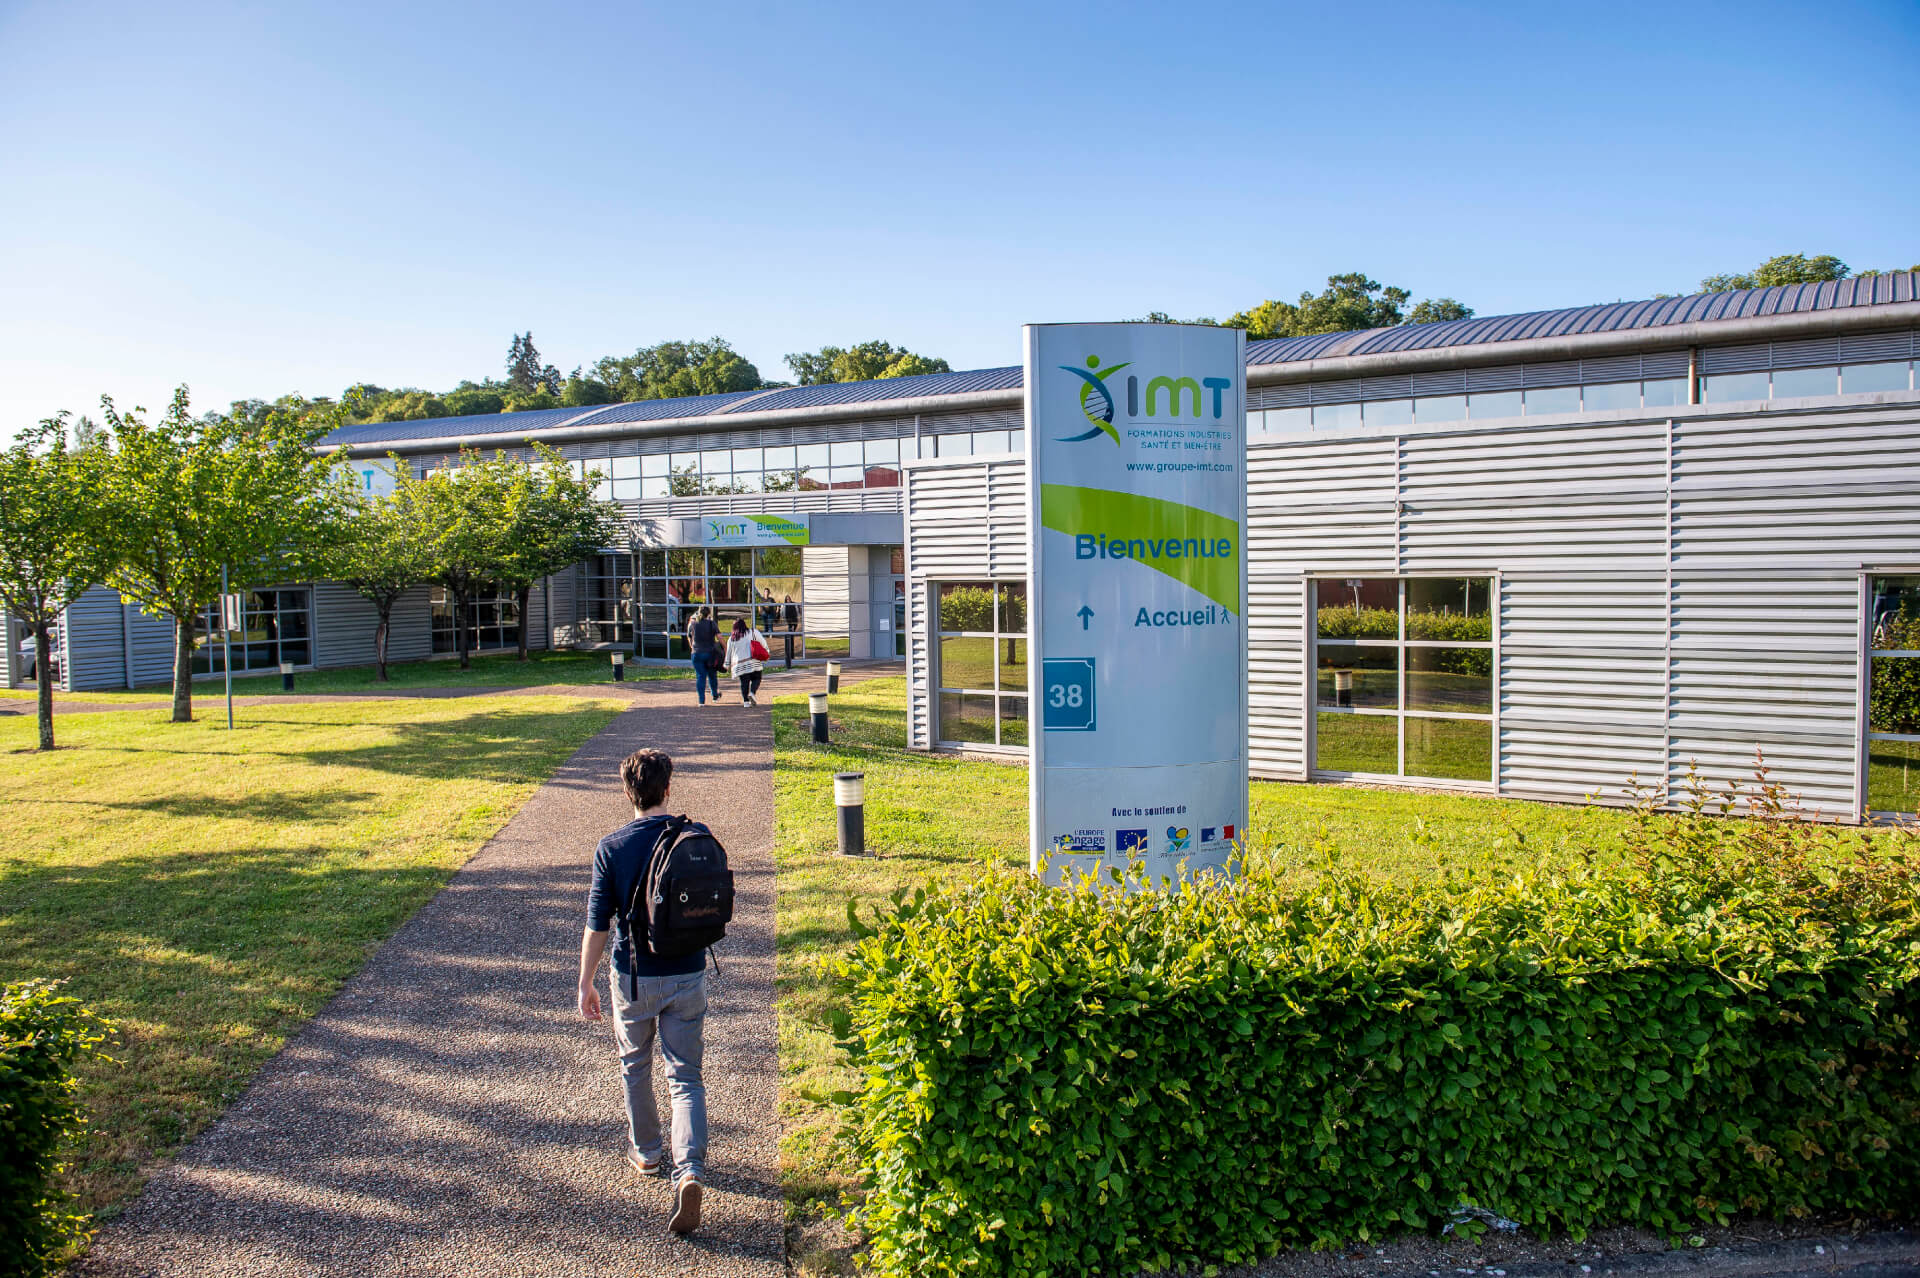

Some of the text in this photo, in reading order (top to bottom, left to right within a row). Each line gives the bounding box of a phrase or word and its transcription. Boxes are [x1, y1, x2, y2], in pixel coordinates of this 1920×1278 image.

[1127, 429, 1233, 439] FORMATIONS INDUSTRIES
[1140, 440, 1223, 450] SANTÉ ET BIEN-ÊTRE
[1126, 461, 1233, 473] www.groupe-imt.com
[756, 522, 805, 530] Bienvenue
[1075, 533, 1232, 560] Bienvenue
[1134, 604, 1216, 627] Accueil
[1049, 683, 1084, 708] 38
[1111, 804, 1187, 817] Avec le soutien de
